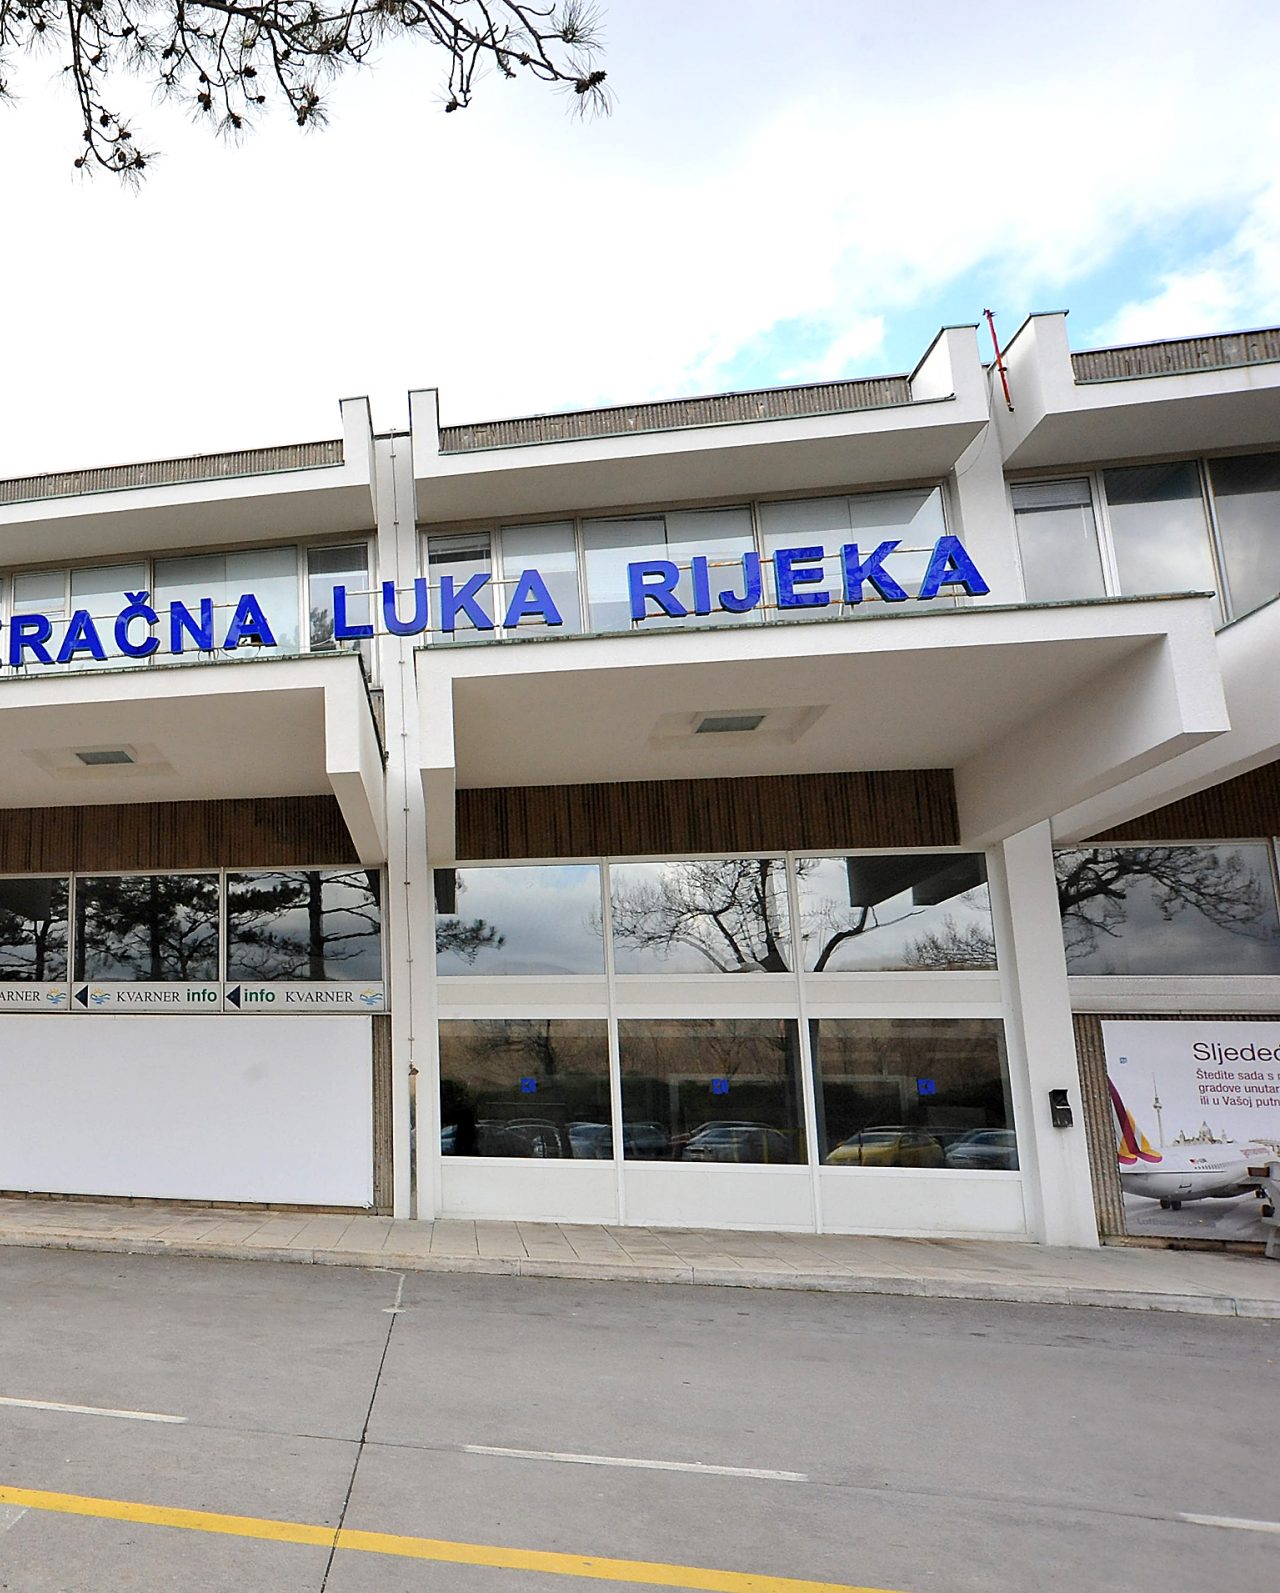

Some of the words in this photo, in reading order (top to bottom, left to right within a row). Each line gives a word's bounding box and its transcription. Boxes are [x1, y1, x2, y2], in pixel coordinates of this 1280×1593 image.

[333, 569, 563, 641] LUKA
[627, 535, 990, 621] RIJEKA
[116, 990, 181, 1003] KVARNER
[187, 988, 218, 1003] info
[244, 988, 275, 1003] info
[285, 990, 354, 1003] KVARNER
[1196, 1068, 1234, 1080] Štedite
[1238, 1071, 1264, 1080] sada
[1198, 1083, 1241, 1094] gradove
[1213, 1097, 1220, 1105] u
